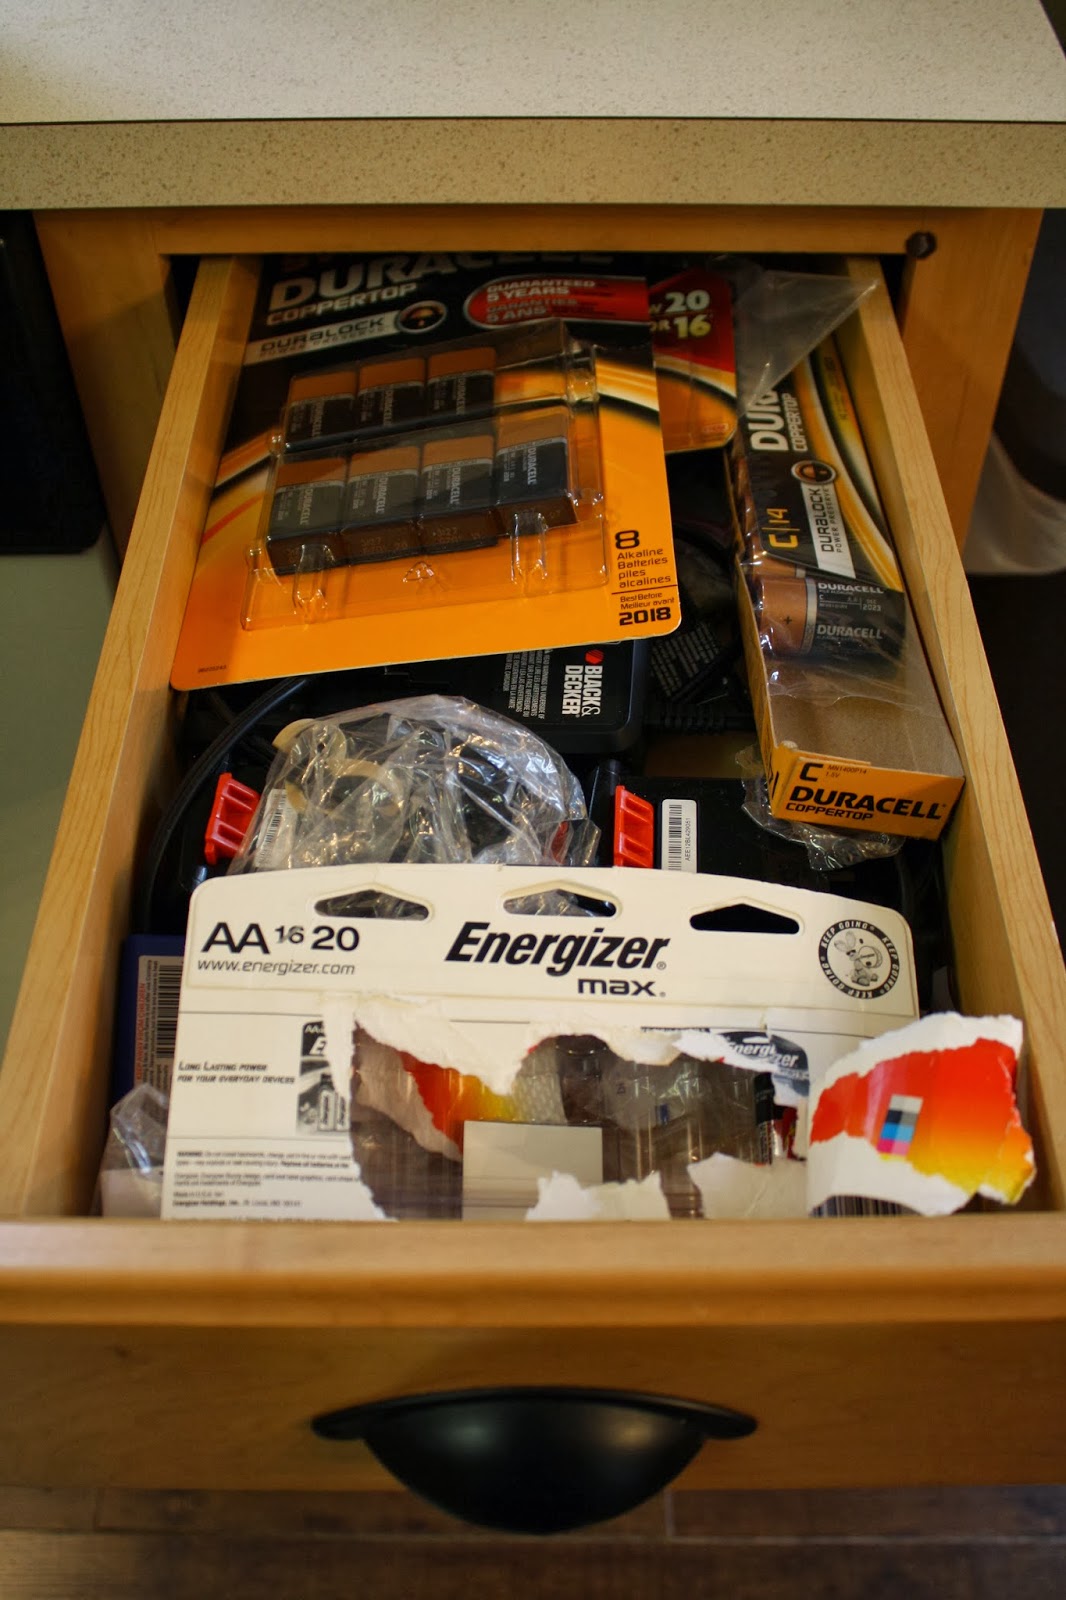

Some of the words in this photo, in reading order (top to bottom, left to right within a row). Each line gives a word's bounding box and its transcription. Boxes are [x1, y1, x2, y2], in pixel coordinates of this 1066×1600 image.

[487, 279, 596, 293] GUARANTEED
[487, 290, 499, 302] 5
[503, 286, 570, 300] YEARS
[266, 282, 418, 326] COPPERTOP
[665, 289, 711, 313] 20
[503, 305, 547, 320] ANS
[673, 314, 712, 340] 16
[782, 392, 808, 452] COPPERTOP
[527, 446, 538, 486] DURACELL
[375, 475, 389, 514] DURACELL
[449, 467, 462, 504] DURACELL
[766, 507, 791, 525] 14
[823, 487, 838, 525] PRESERVE
[615, 530, 640, 550] 8
[768, 533, 799, 549] C
[828, 526, 843, 554] POWER
[617, 548, 663, 561] Alkaline
[618, 557, 668, 570] Batteries
[618, 569, 646, 581] piles
[619, 575, 671, 588] alcalines
[620, 595, 637, 603] Best
[637, 592, 662, 601] Before
[817, 582, 885, 594] DURACELL
[620, 602, 651, 610] Meilleur
[652, 598, 675, 606] avant
[619, 606, 672, 627] 2018
[816, 624, 884, 640] DURACELL
[562, 665, 583, 715] DECKER
[799, 762, 824, 783] C
[785, 802, 875, 822] COPPERTOP
[789, 785, 943, 820] DURACELL
[201, 922, 271, 954] AA
[275, 926, 305, 944] 16
[311, 926, 361, 952] 20
[821, 927, 836, 949] KEEP
[838, 920, 868, 930] GOING
[444, 921, 670, 977] Energizer
[881, 936, 898, 959] KEEP
[197, 959, 356, 976] www.energizer.com
[821, 962, 846, 990] GOING
[883, 963, 900, 991] GOING
[577, 978, 657, 997] max
